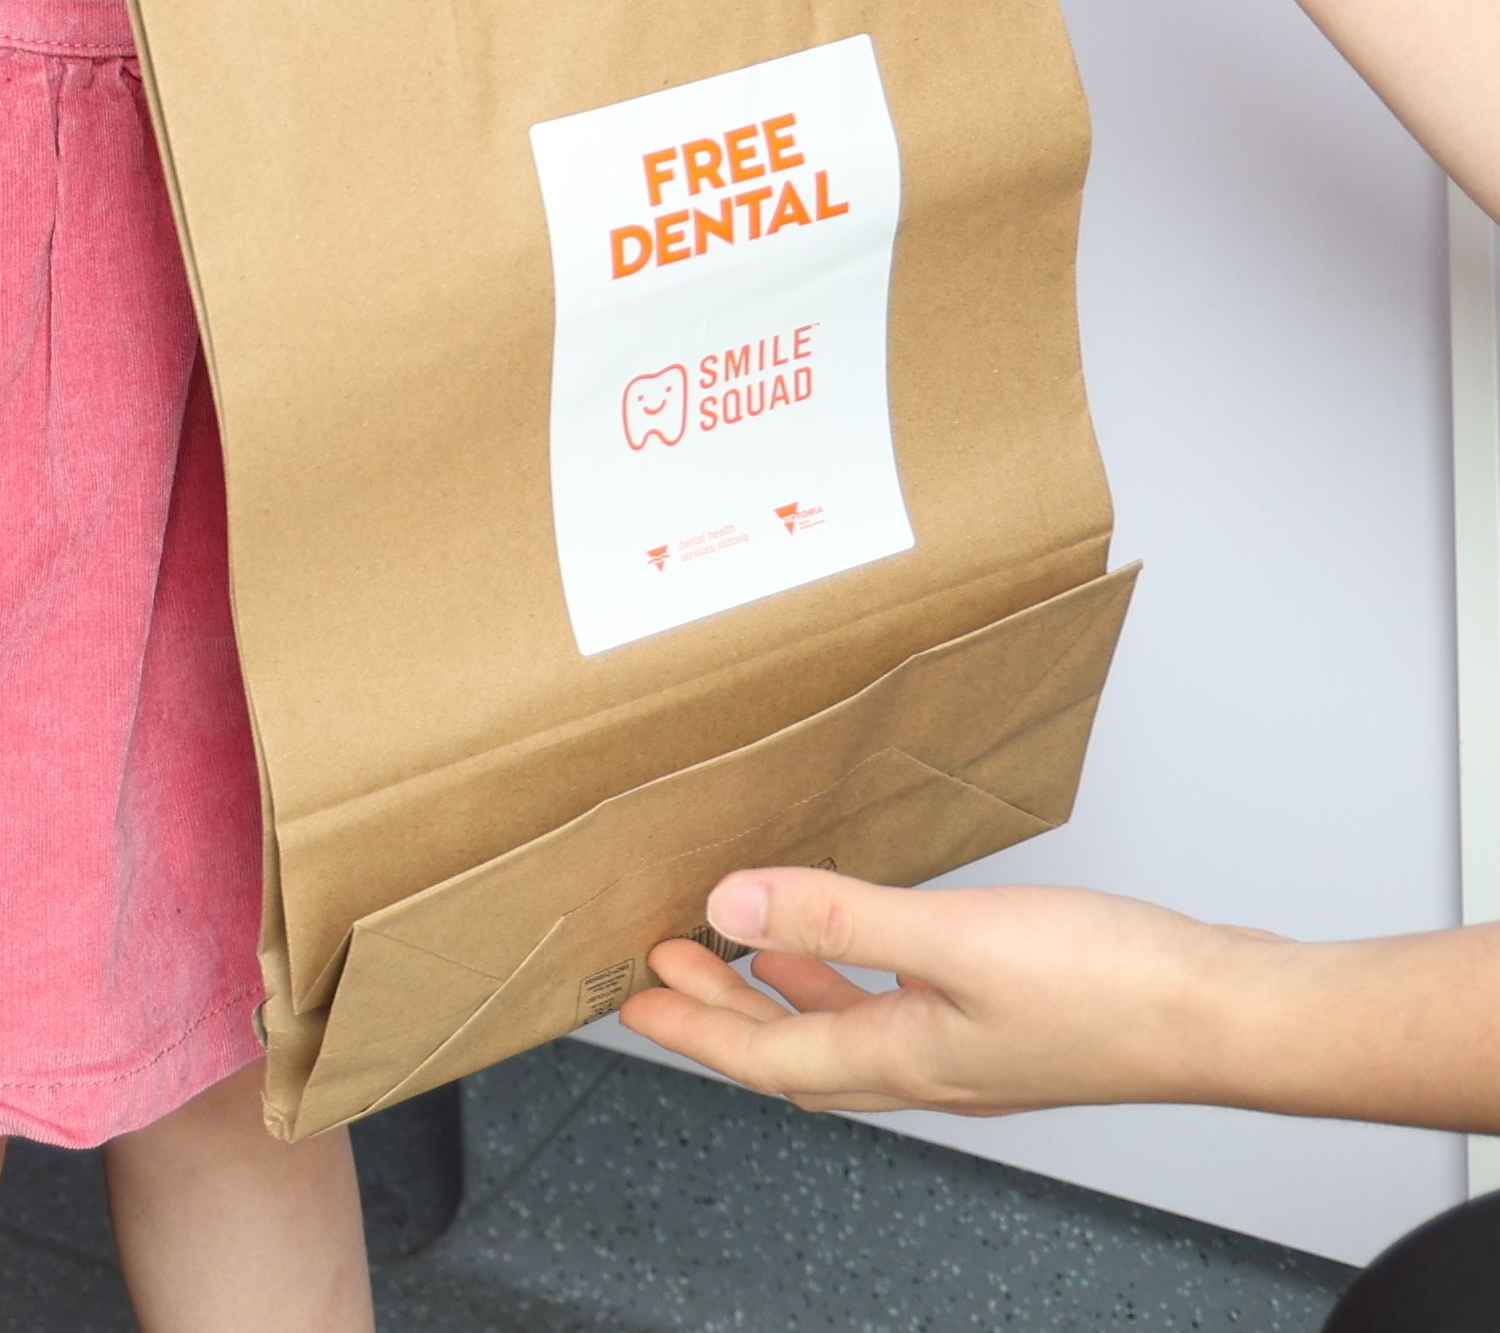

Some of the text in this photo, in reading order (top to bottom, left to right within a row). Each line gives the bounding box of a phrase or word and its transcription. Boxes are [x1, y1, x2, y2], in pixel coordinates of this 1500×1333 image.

[641, 112, 806, 208] FREE
[609, 170, 850, 280] DENTAL
[699, 324, 815, 391] SMILE
[699, 366, 814, 432] SQUAD
